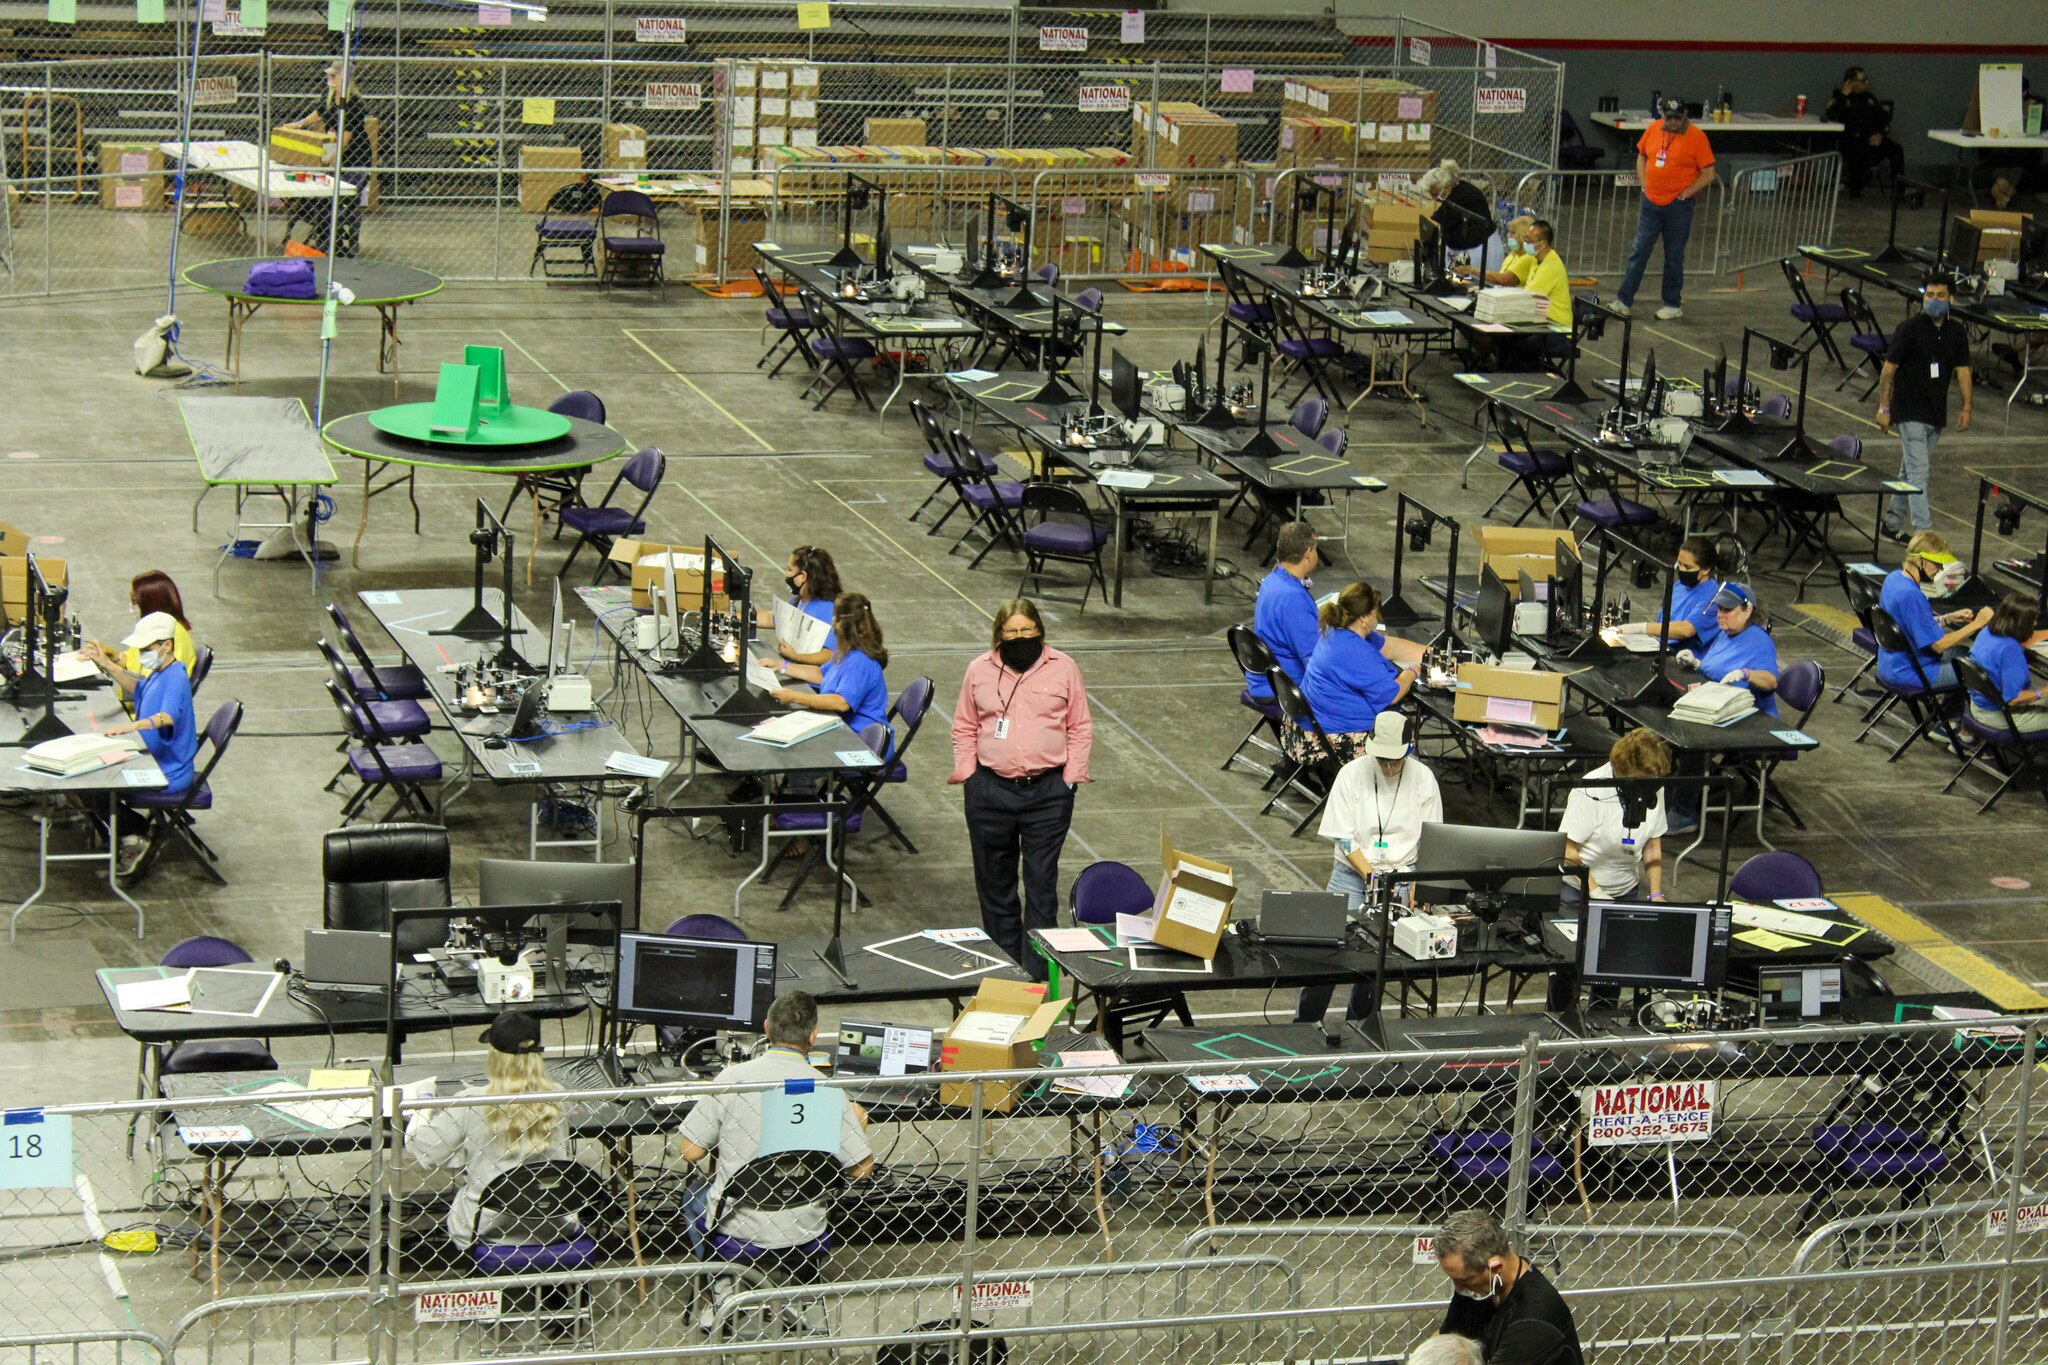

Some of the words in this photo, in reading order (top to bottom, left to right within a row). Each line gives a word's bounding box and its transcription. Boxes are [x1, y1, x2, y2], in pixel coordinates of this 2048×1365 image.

[638, 19, 684, 30] NATIONAL
[1042, 28, 1087, 39] NATIONAL
[194, 79, 235, 91] ATIONAL
[648, 84, 699, 96] NATIONAL
[1081, 87, 1128, 99] NATIONAL
[1479, 90, 1525, 100] NATIONAL
[1593, 1083, 1710, 1116] NATIONAL
[790, 1103, 805, 1124] 3
[1593, 1111, 1709, 1127] RENT-A-FENCE
[1593, 1122, 1708, 1138] 800-352-5675
[9, 1134, 42, 1158] 18
[1990, 1205, 2048, 1225] NAONAL
[420, 1292, 498, 1309] NATIONAL
